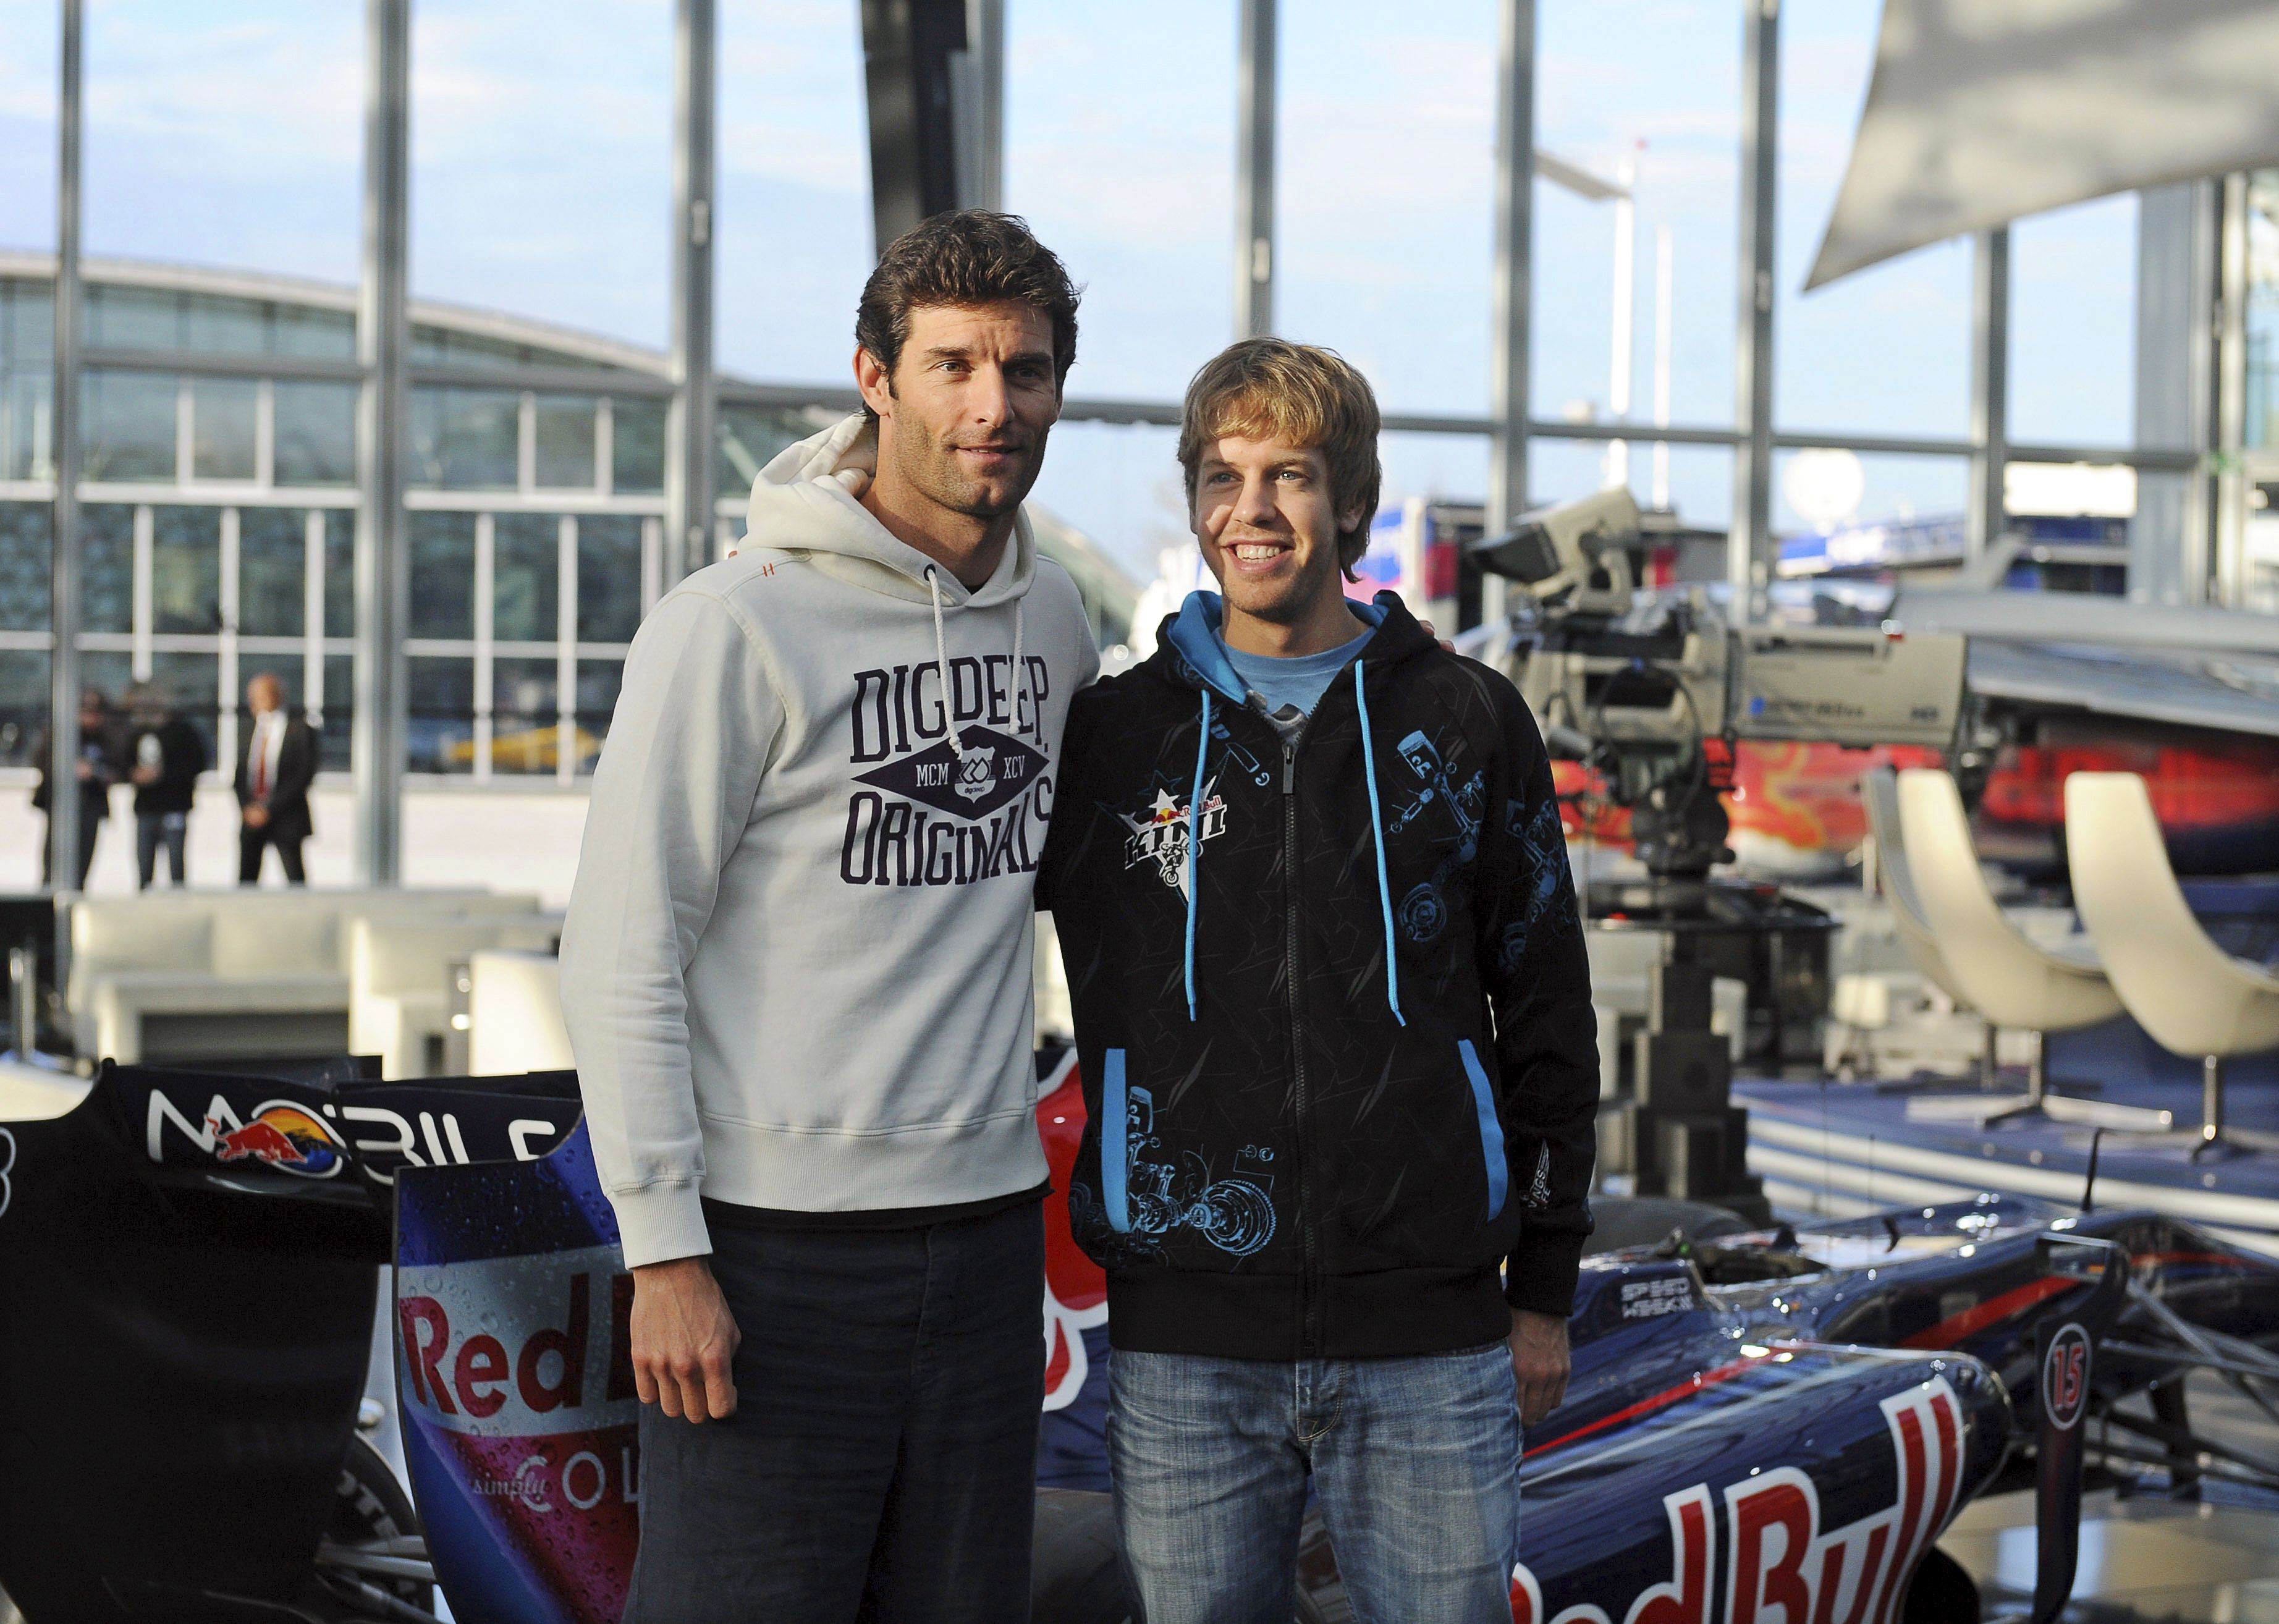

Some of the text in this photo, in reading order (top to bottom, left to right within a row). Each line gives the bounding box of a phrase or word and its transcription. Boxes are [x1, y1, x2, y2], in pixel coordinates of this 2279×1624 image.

[916, 756, 1026, 787] MCM XCV
[399, 1272, 590, 1418] Red
[2053, 1342, 2085, 1411] 15
[474, 1471, 548, 1502] simply
[516, 1446, 639, 1513] COL
